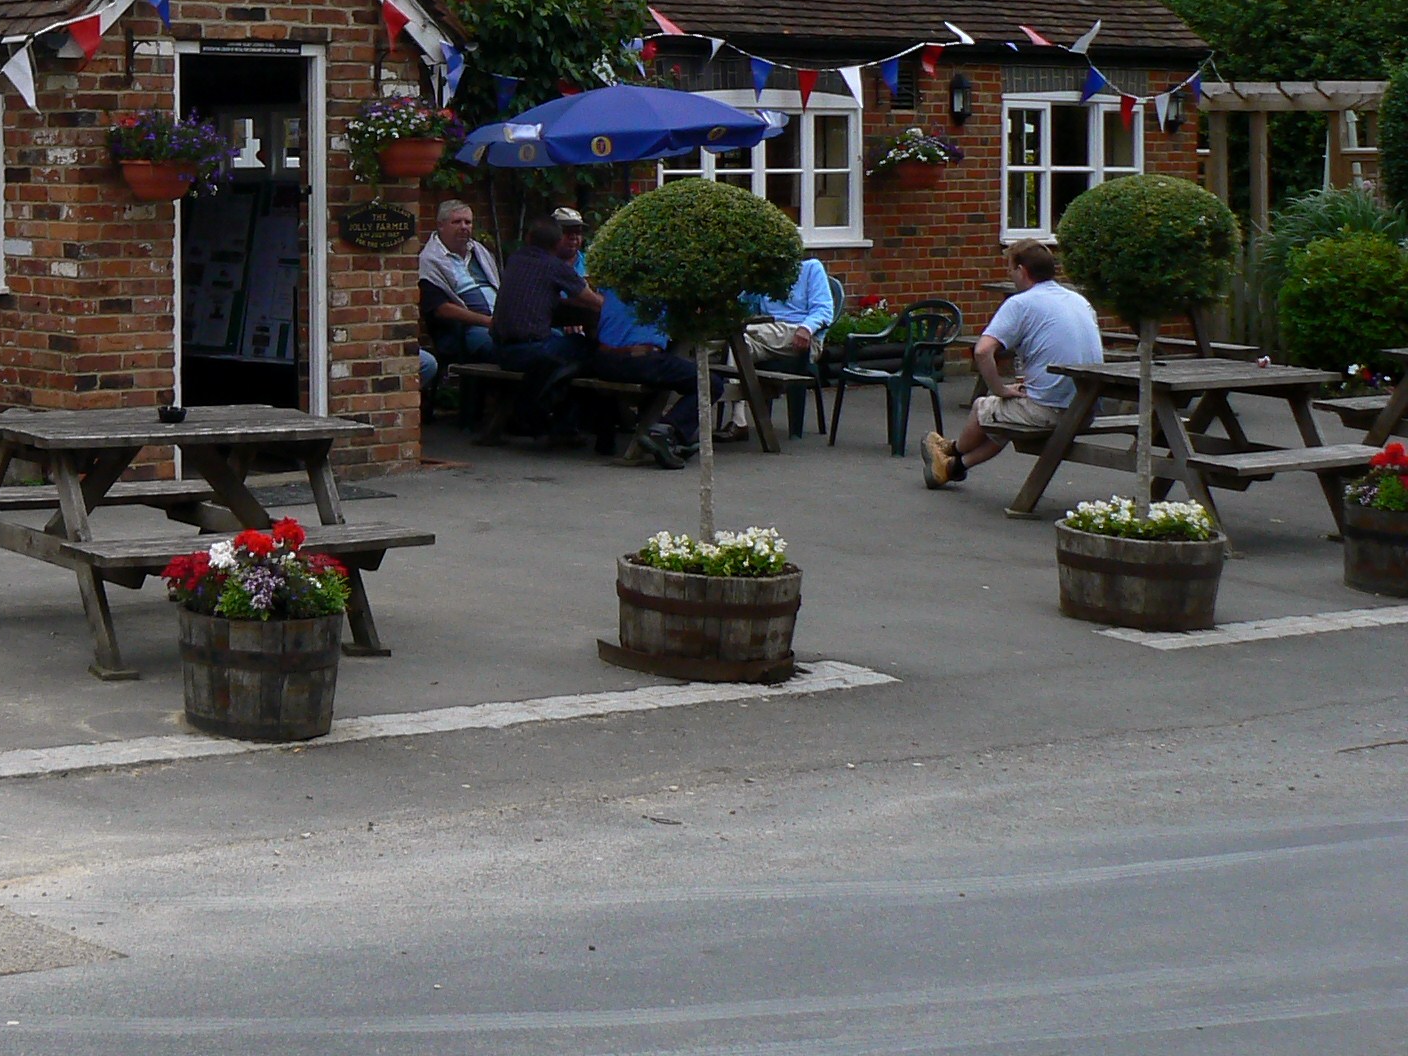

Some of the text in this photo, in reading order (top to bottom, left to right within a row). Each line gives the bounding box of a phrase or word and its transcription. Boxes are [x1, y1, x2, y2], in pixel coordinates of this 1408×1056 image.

[372, 213, 387, 221] THE
[349, 222, 409, 231] JOLLY FARMER
